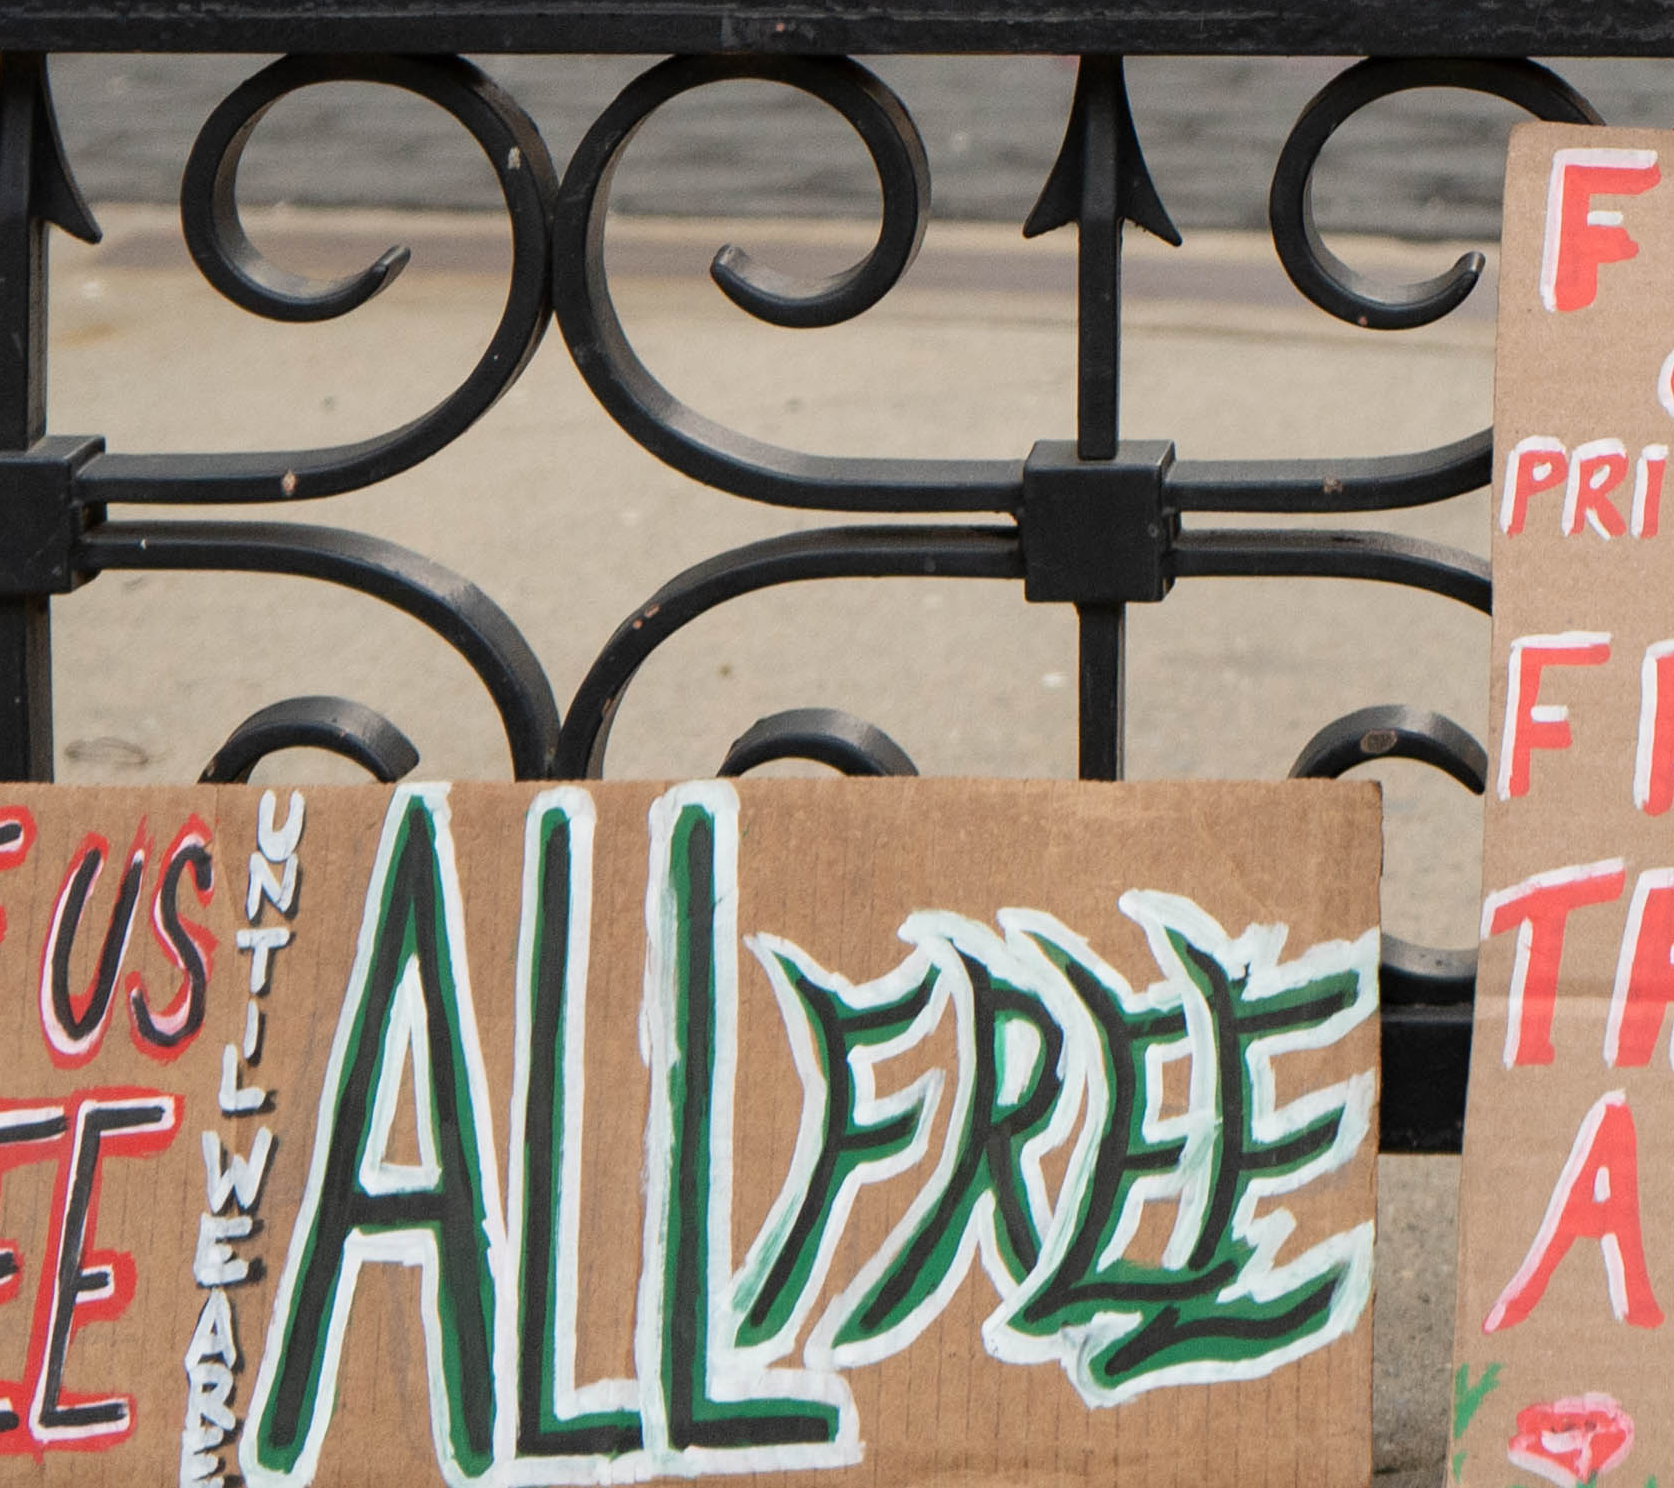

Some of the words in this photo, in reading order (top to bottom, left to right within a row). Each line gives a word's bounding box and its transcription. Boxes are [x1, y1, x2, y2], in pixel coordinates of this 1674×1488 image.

[39, 816, 217, 1065] US
[222, 790, 304, 1113] UNTIL
[194, 1126, 273, 1288] WE
[241, 781, 862, 1488] ALL
[731, 891, 1378, 1408] FREE
